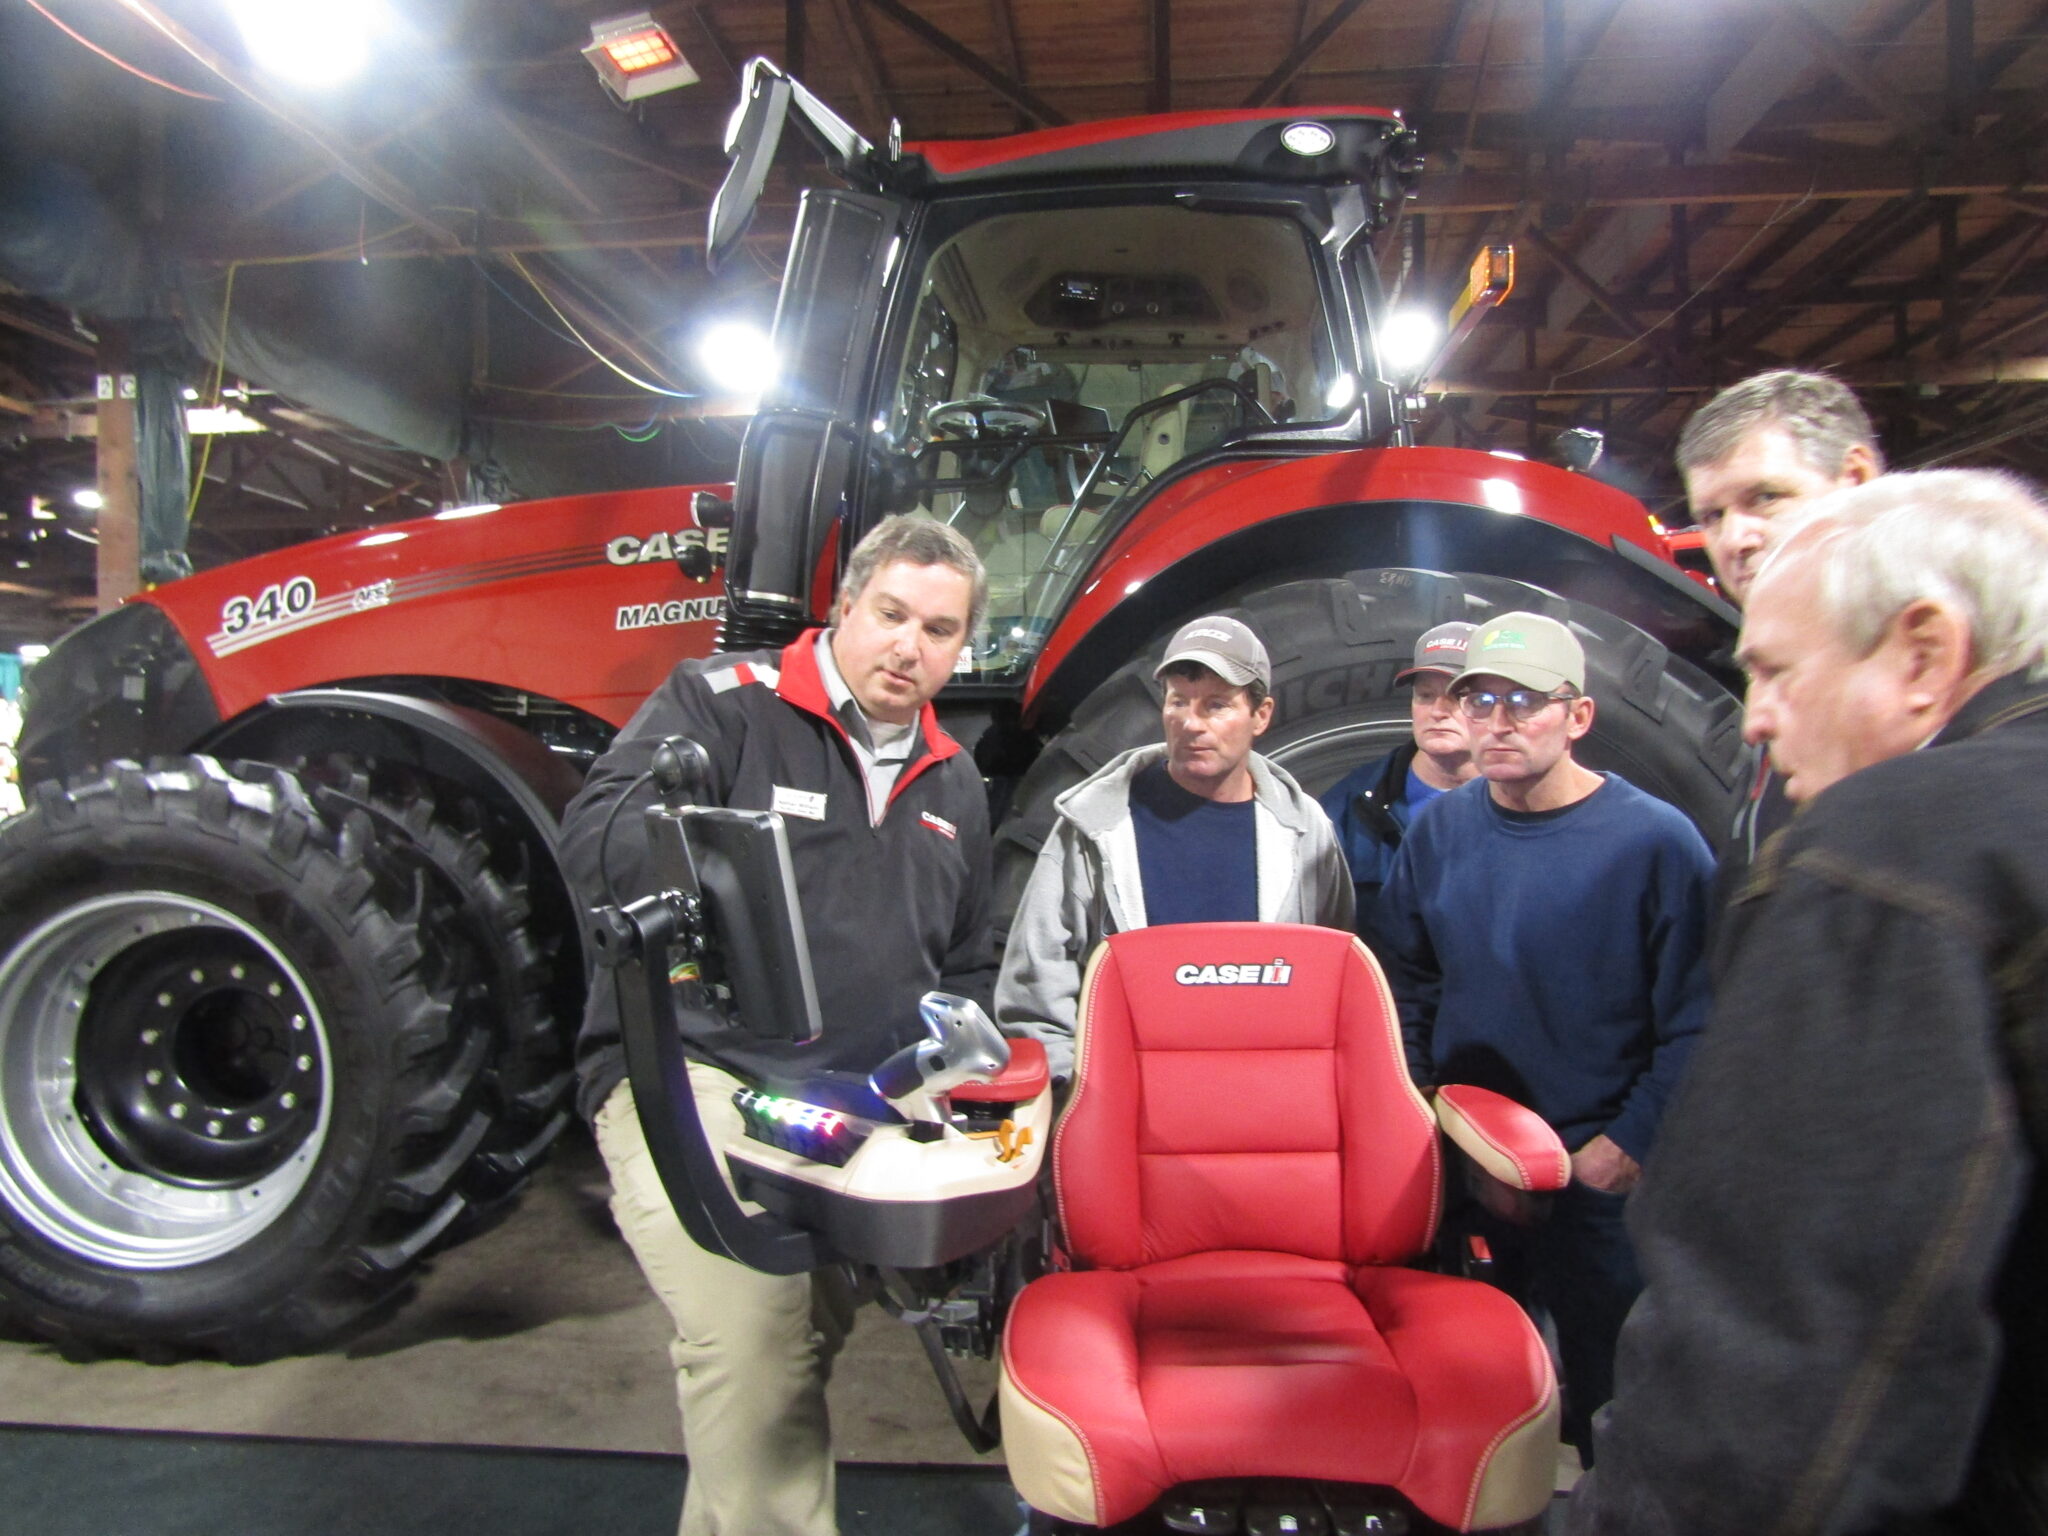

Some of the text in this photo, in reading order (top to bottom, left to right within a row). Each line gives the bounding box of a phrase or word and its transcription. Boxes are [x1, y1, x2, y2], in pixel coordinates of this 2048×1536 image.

[606, 527, 730, 566] CASE
[222, 576, 316, 636] 340
[616, 597, 727, 630] MAGNU
[1175, 964, 1261, 985] CASE
